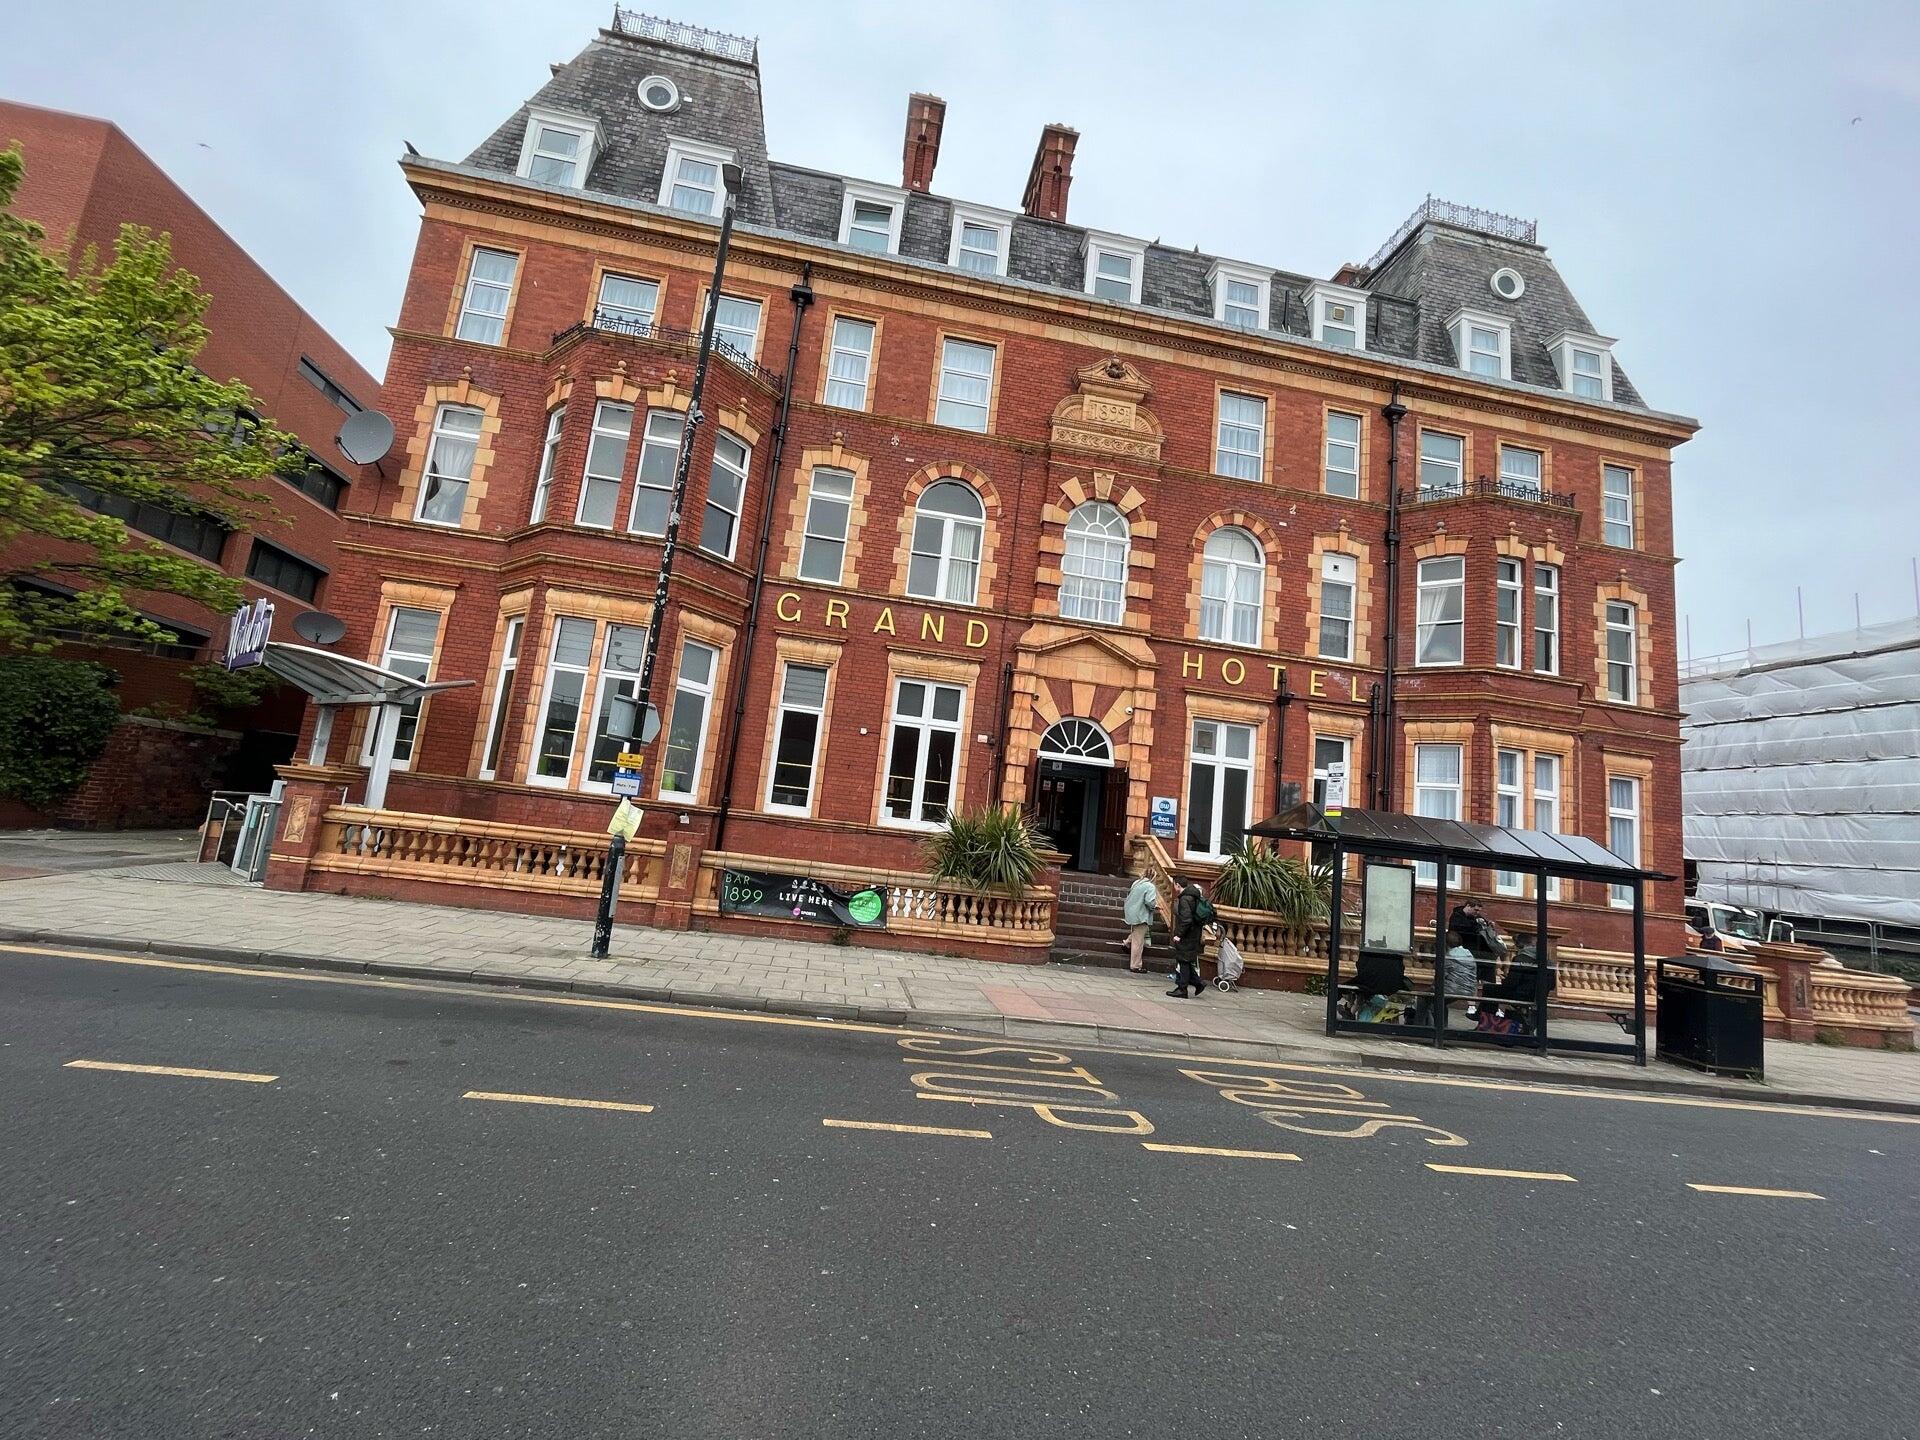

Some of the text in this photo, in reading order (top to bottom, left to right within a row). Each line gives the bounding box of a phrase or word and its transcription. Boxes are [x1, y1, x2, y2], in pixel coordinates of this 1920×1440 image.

[1092, 404, 1125, 423] 1899
[776, 592, 1367, 703] GRAND HOTEL
[725, 873, 750, 885] BAR
[724, 885, 763, 903] 1899
[779, 892, 833, 907] LIVE HERE
[896, 1037, 1155, 1135] STOP
[1178, 1068, 1469, 1148] BUS
